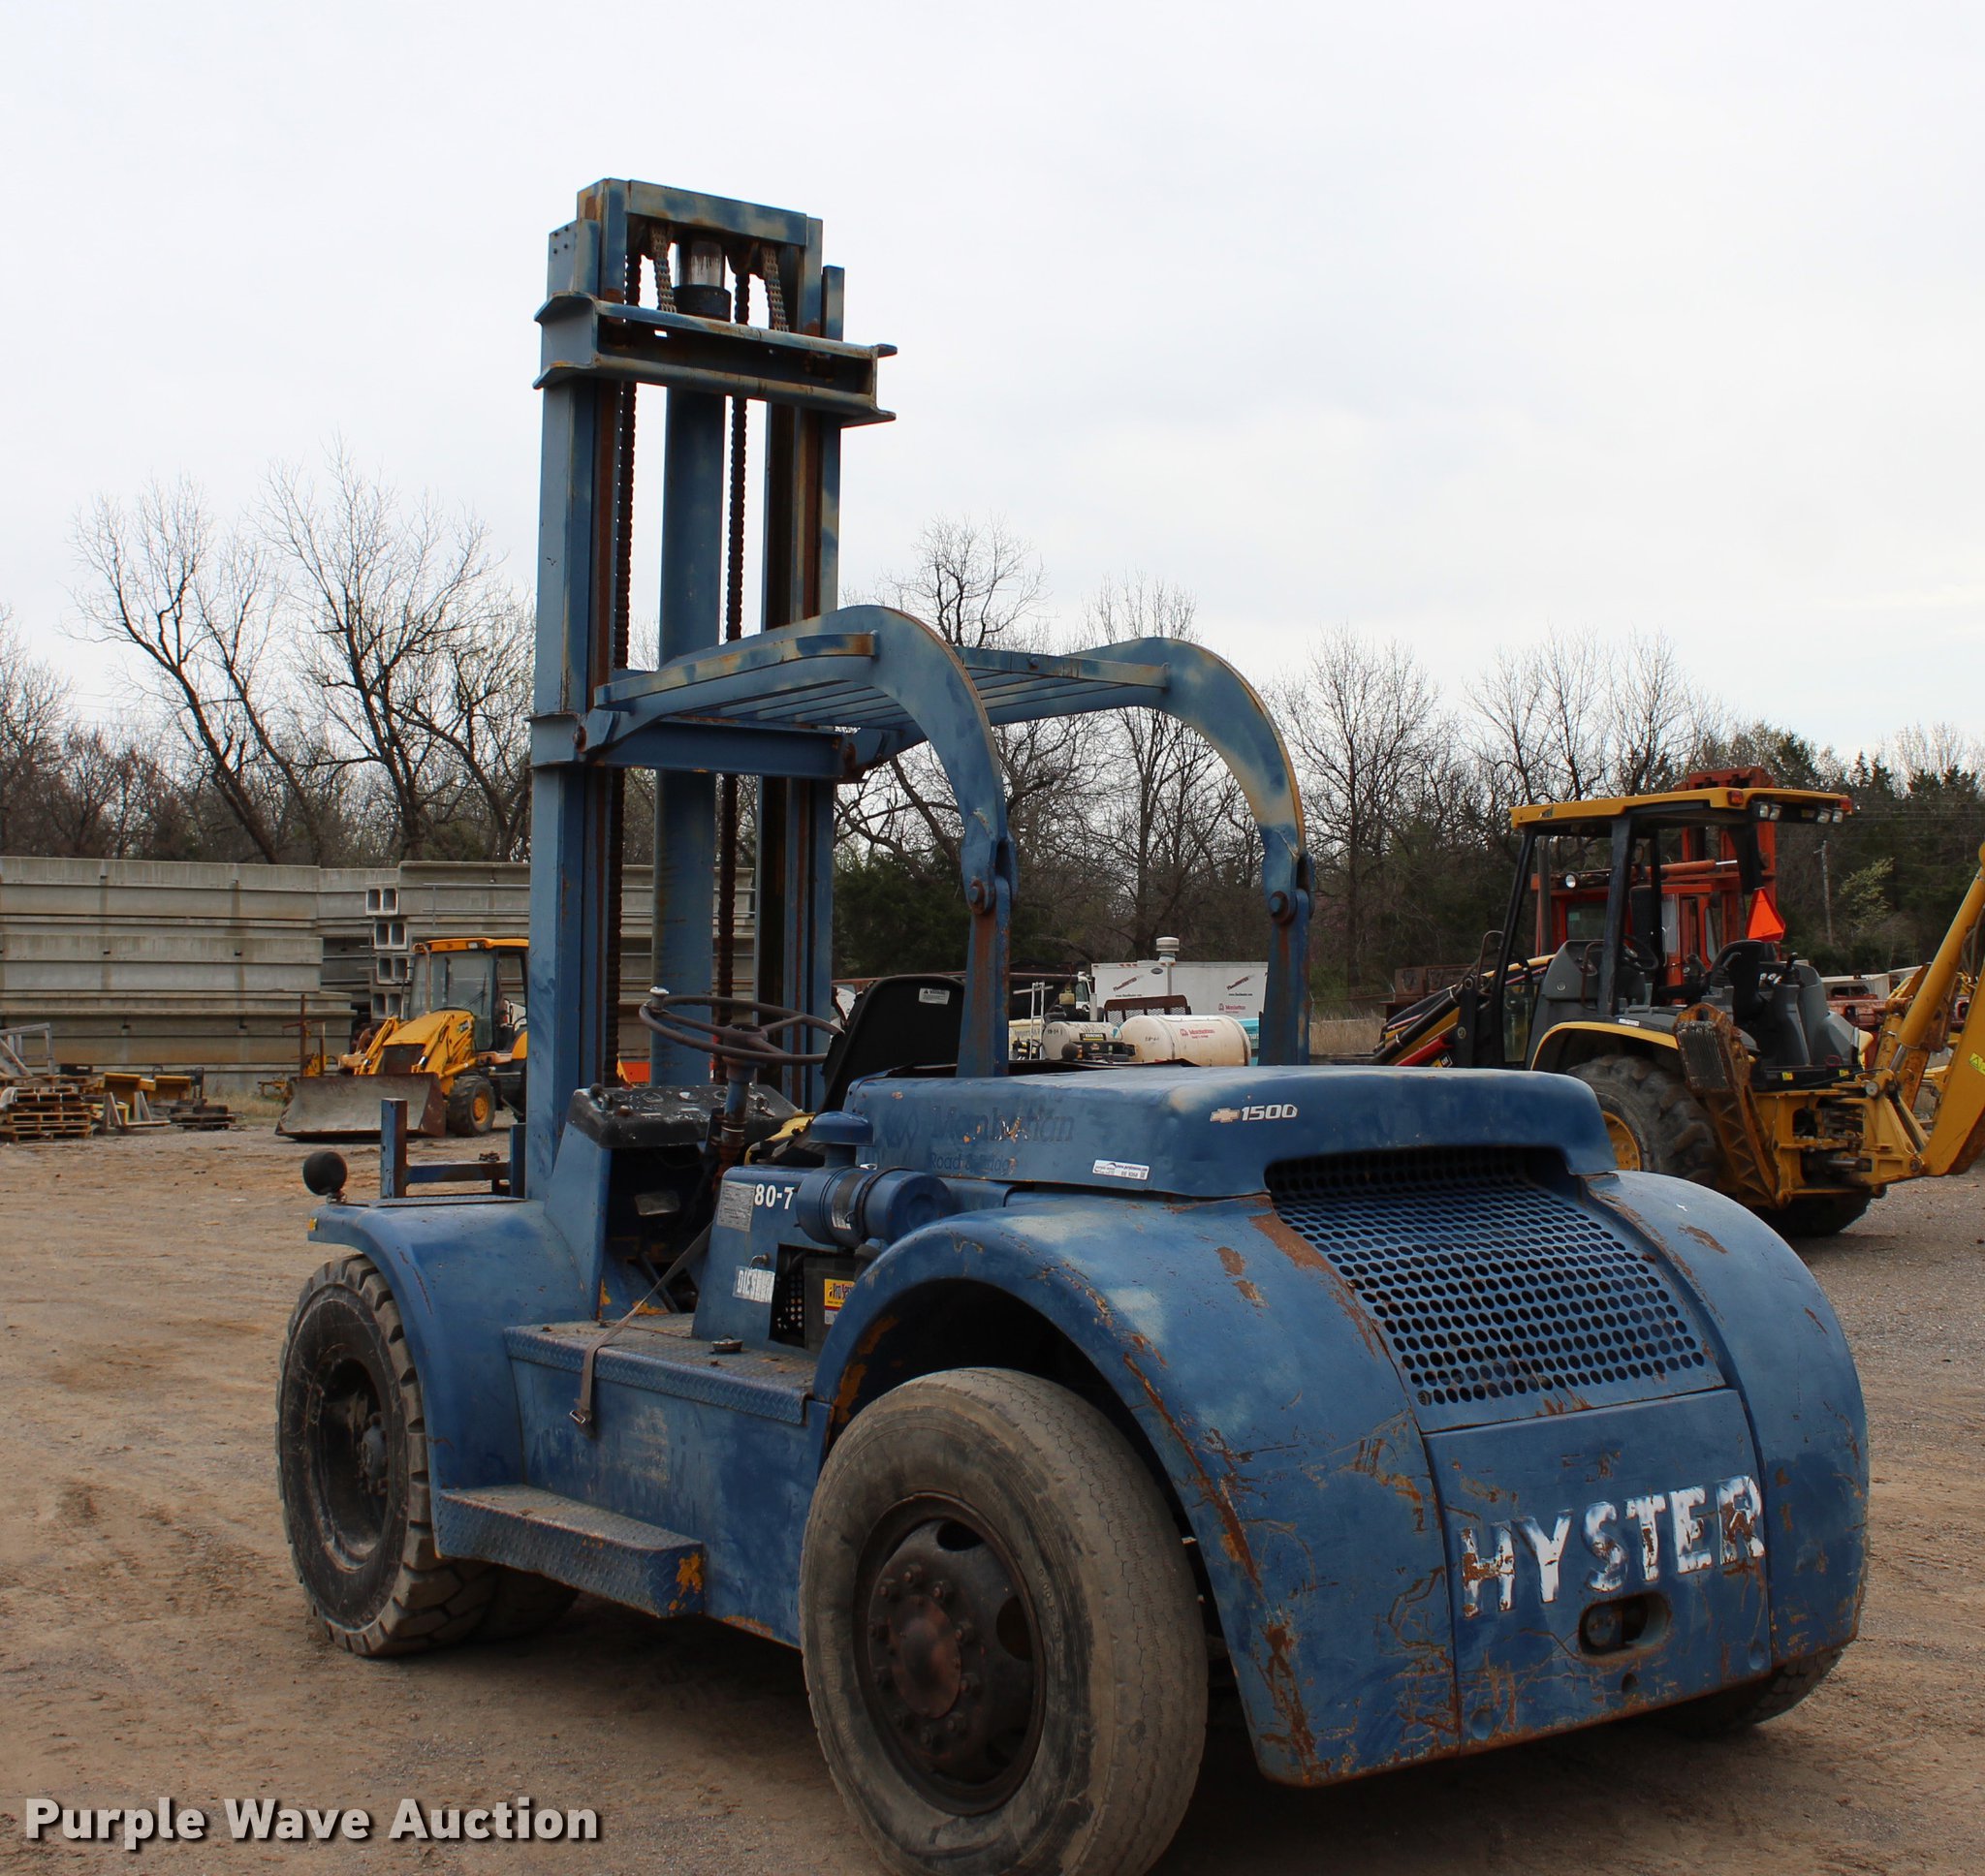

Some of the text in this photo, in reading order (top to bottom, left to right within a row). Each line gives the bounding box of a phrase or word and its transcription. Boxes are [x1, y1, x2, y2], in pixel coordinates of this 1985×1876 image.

[1242, 1104, 1298, 1121] 1500
[754, 1183, 795, 1209] 80-7
[1461, 1475, 1765, 1619] HYSTER
